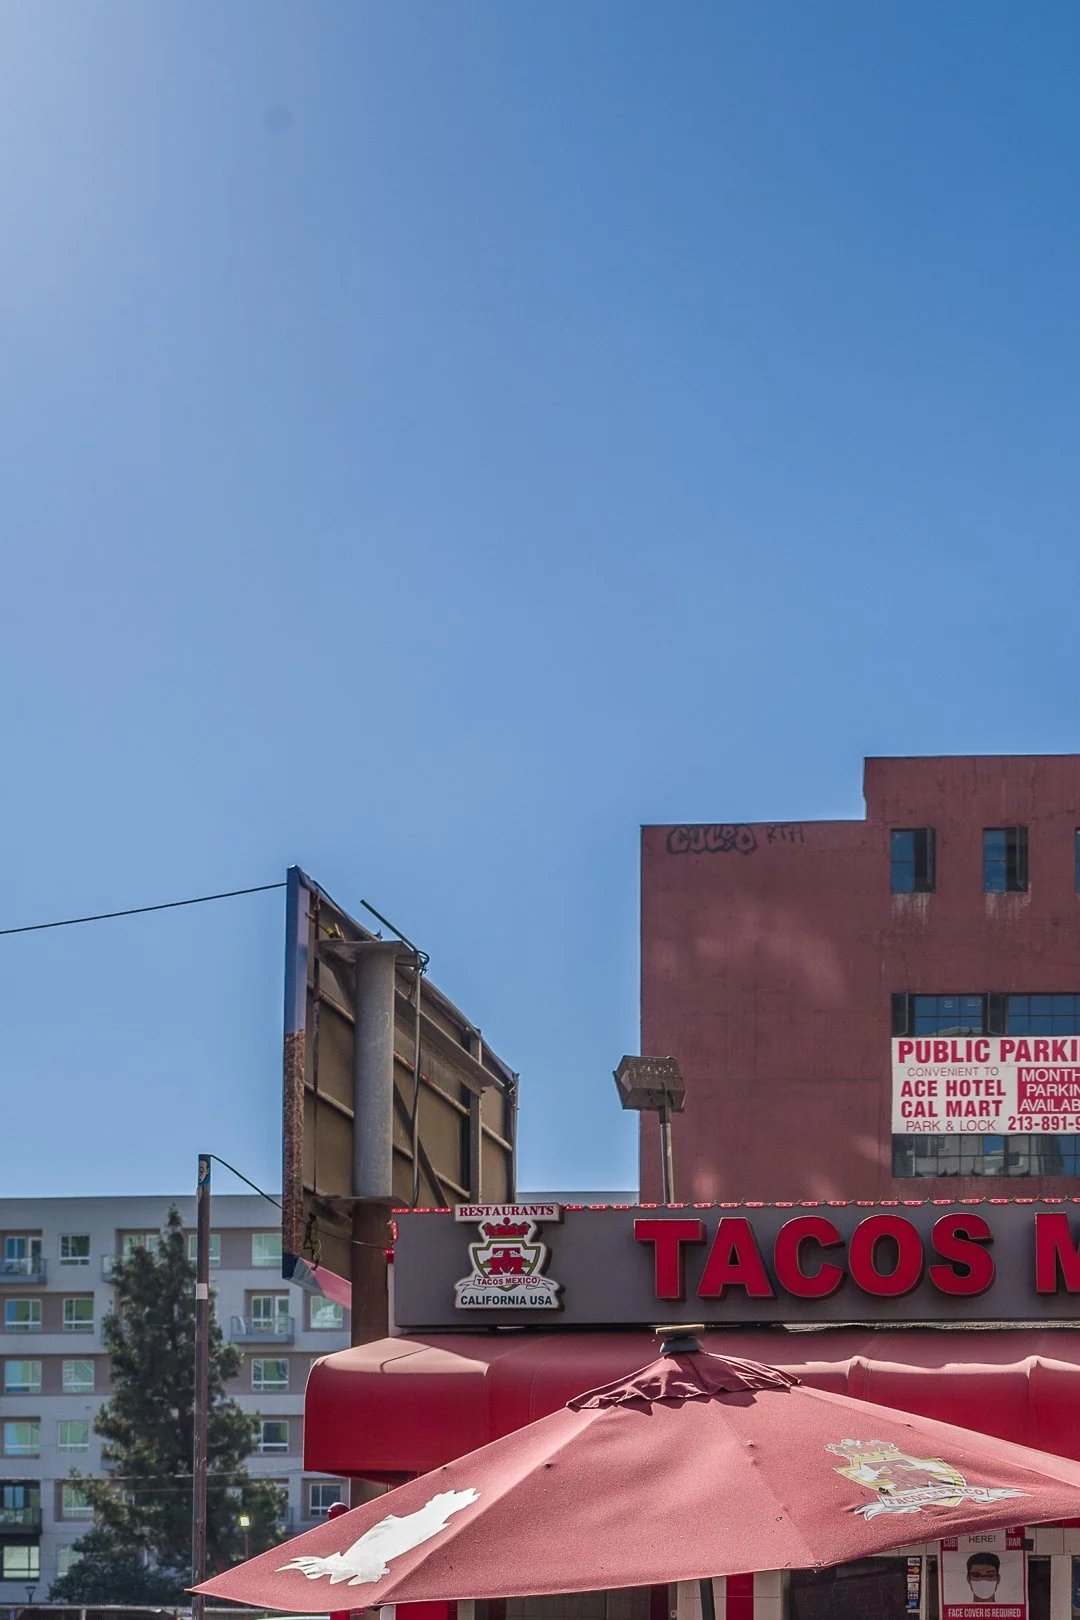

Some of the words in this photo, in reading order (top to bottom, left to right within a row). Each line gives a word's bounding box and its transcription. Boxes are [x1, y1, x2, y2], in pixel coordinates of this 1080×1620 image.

[898, 1039, 991, 1064] PUBLIC
[907, 1067, 979, 1077] CONVENIENT
[984, 1067, 1000, 1076] TO
[900, 1080, 938, 1097] ACE
[945, 1079, 1007, 1097] HOTEL
[901, 1100, 938, 1118] CAL
[945, 1100, 1003, 1117] MART
[906, 1120, 940, 1132] PARK
[945, 1120, 954, 1131] &
[960, 1119, 997, 1131] LOCK
[459, 1205, 554, 1217] RESTAURANTS
[633, 1212, 996, 1299] TACOS
[476, 1278, 504, 1286] TACOS
[460, 1295, 528, 1305] CALIFORNIA
[530, 1295, 553, 1305] USA
[968, 1535, 996, 1543] HERE!
[948, 1608, 963, 1618] FACE
[964, 1608, 983, 1618] COVER
[984, 1608, 991, 1618] IS
[991, 1608, 1021, 1618] REQUIRED
